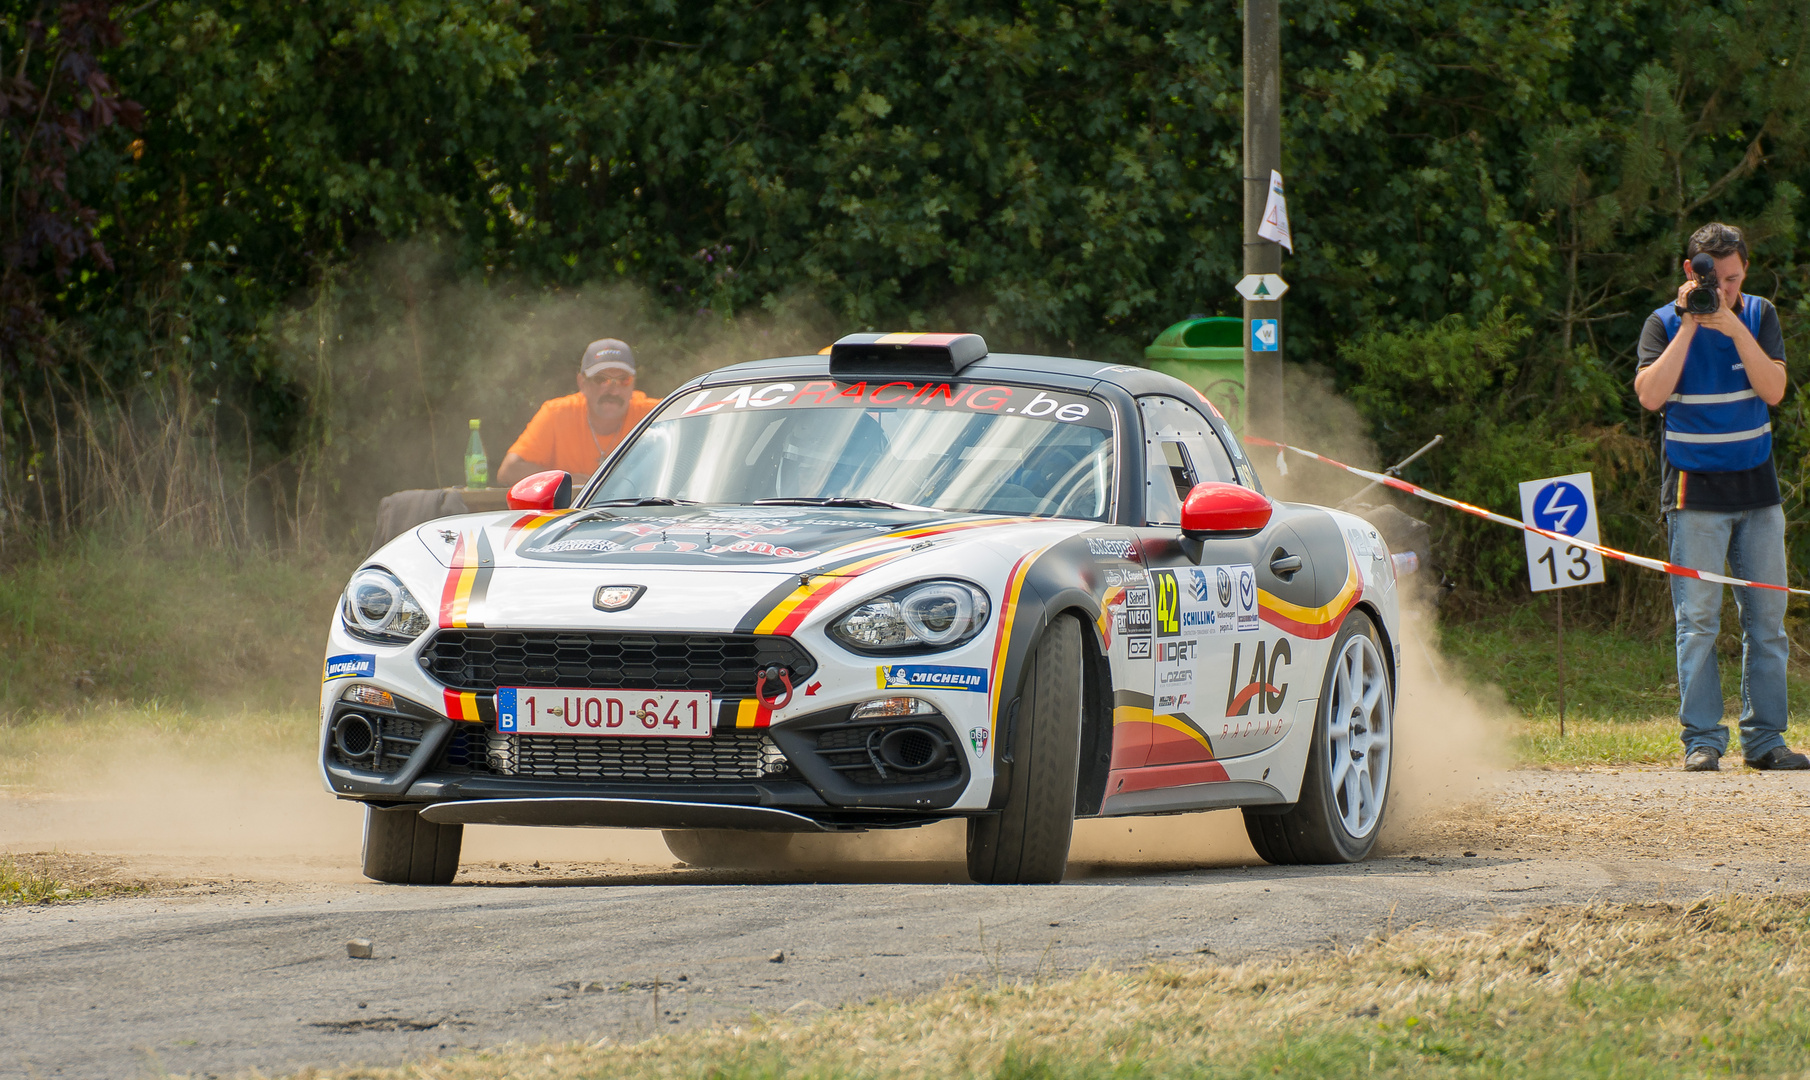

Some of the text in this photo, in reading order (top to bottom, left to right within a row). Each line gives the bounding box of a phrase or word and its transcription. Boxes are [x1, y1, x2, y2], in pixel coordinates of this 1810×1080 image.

[1096, 538, 1137, 558] Kappa
[1538, 544, 1591, 585] 13
[1129, 591, 1146, 604] Sabelt
[1157, 573, 1178, 632] 42
[1128, 610, 1150, 625] IVECO
[1183, 610, 1215, 626] SCHILLING
[329, 660, 369, 673] MICHELIN
[911, 673, 980, 685] MICHELIN
[1225, 637, 1291, 717] LAC
[502, 713, 514, 728] B
[525, 695, 698, 730] 1-UQD-641
[1220, 719, 1283, 740] RACING
